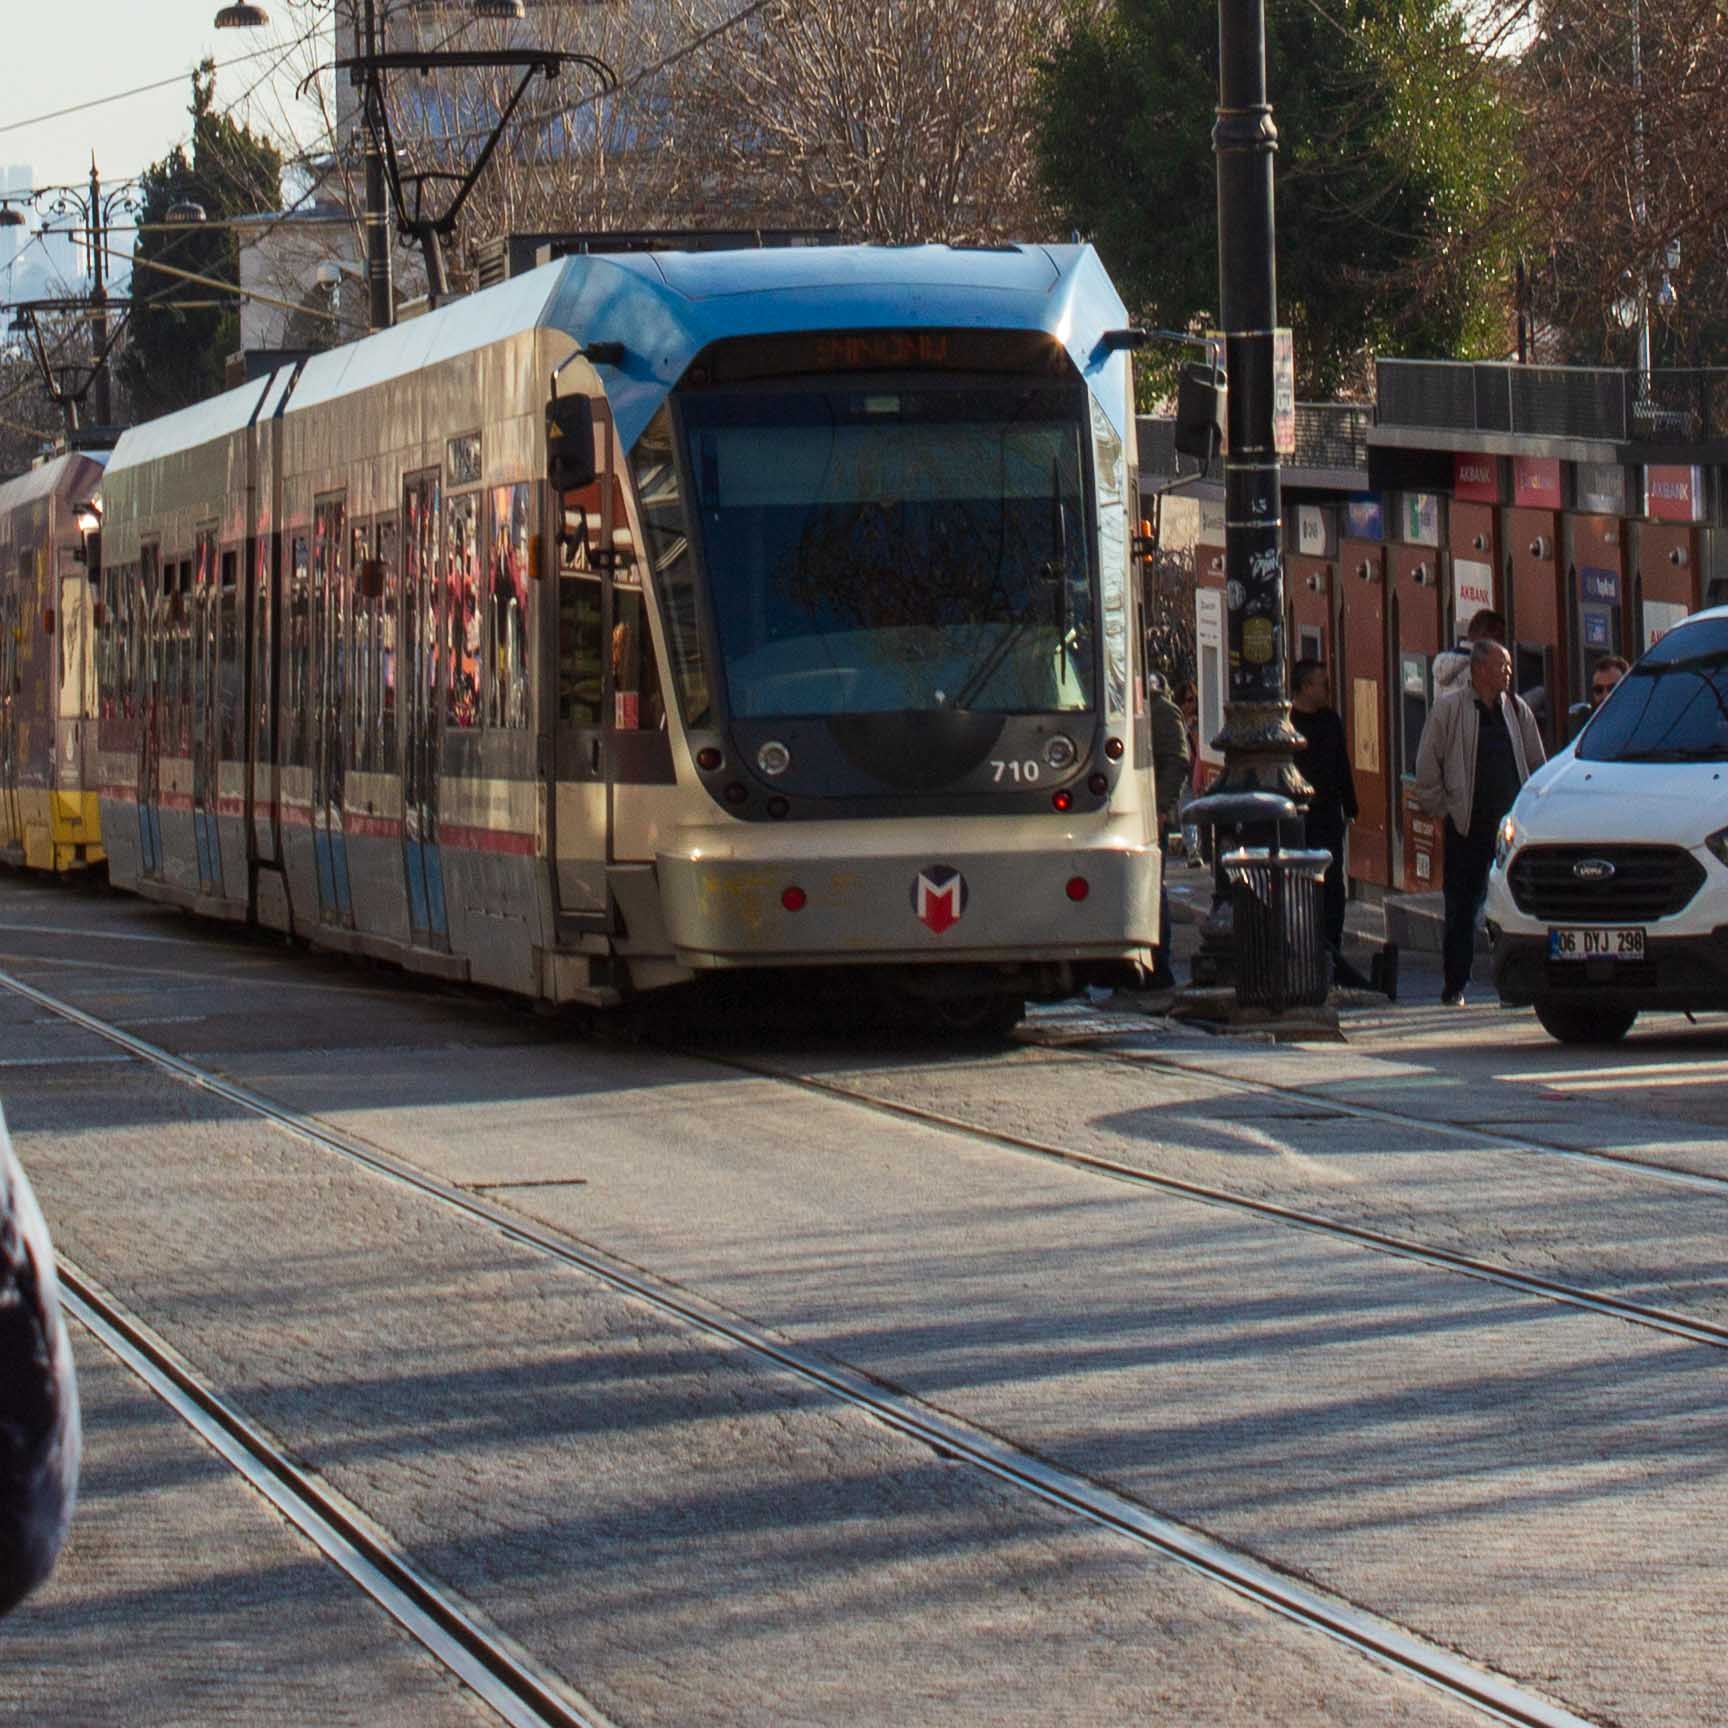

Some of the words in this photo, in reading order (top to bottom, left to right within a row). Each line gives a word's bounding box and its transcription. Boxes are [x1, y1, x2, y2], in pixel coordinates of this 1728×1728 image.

[1651, 481, 1689, 501] AKBANK
[1459, 585, 1490, 608] AKBANK
[989, 759, 1041, 783] 710
[1559, 932, 1576, 953] 06
[1583, 931, 1609, 953] DYJ
[1617, 932, 1642, 953] 298
